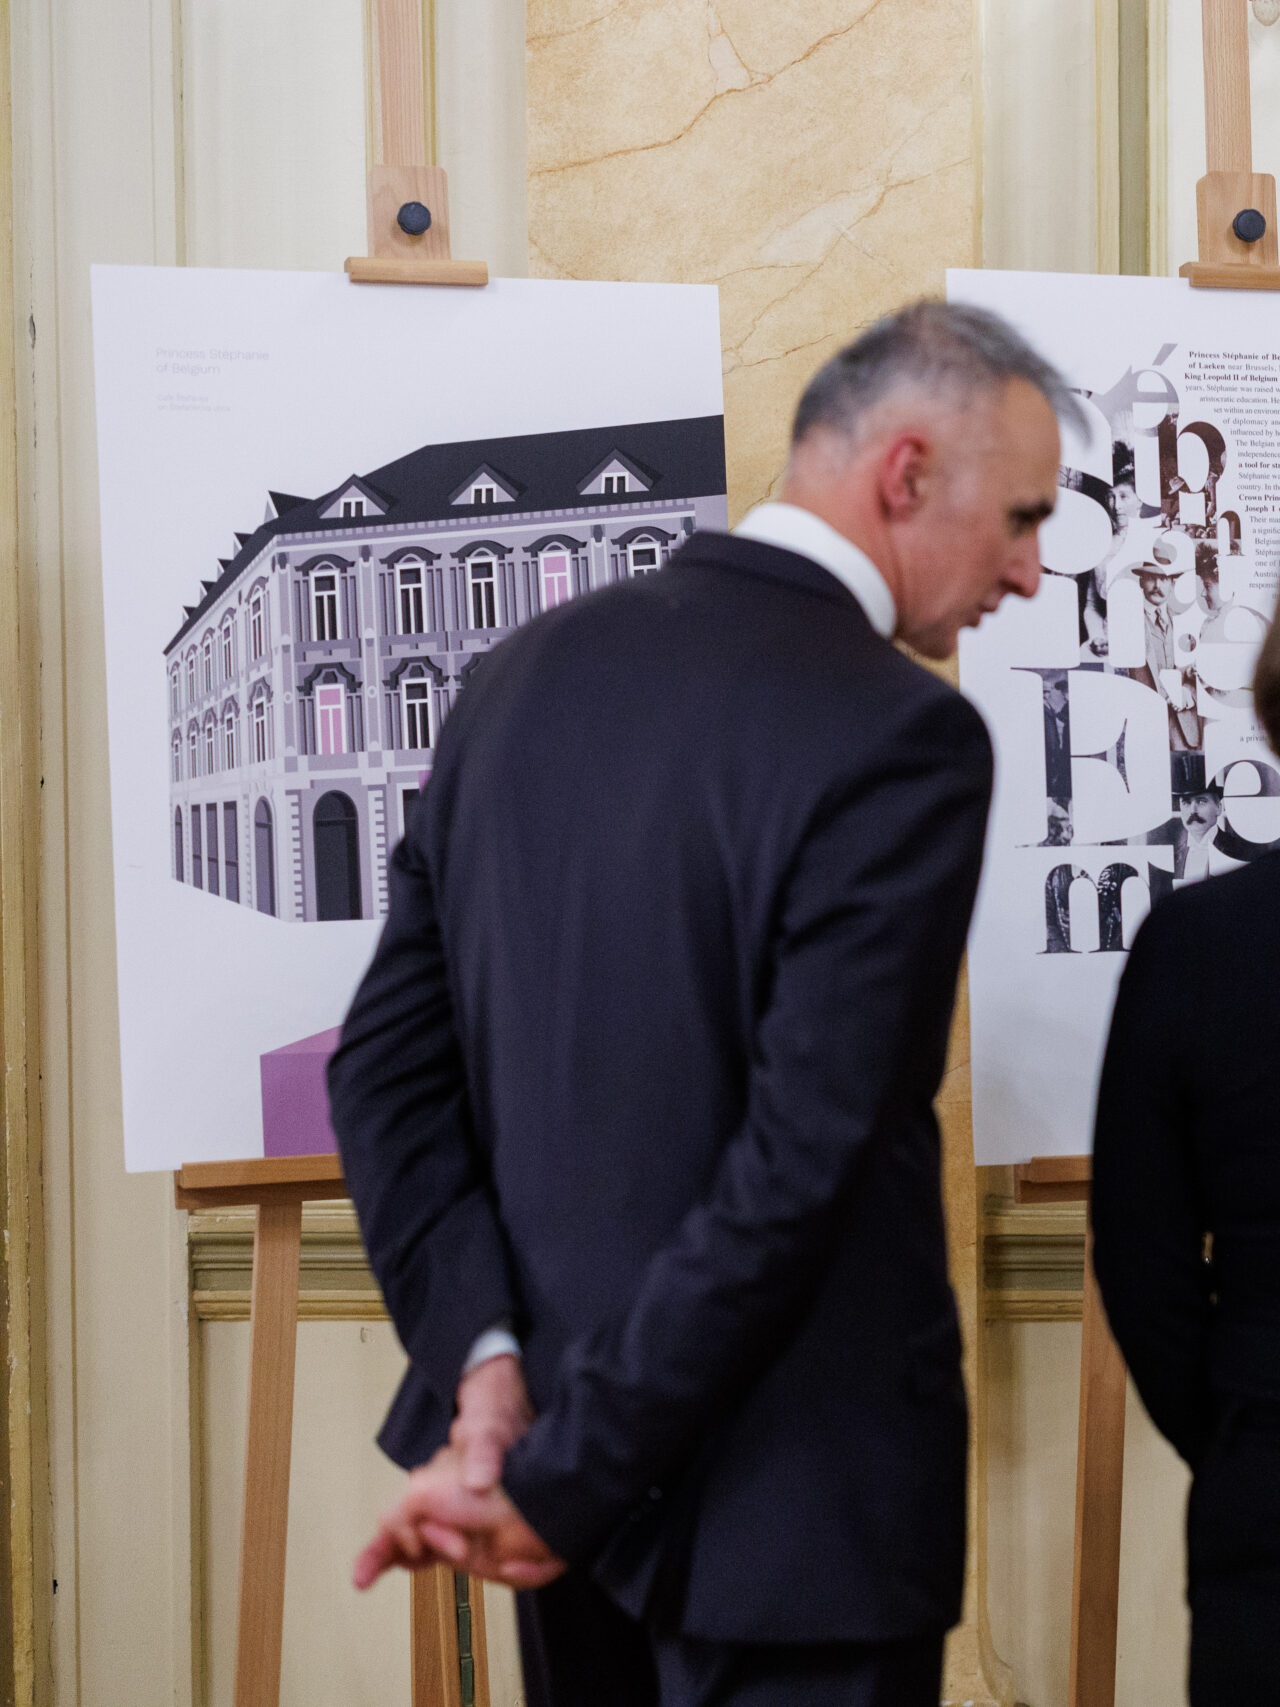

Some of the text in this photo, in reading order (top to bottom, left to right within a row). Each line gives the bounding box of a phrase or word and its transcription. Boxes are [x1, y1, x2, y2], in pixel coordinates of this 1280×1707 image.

[1188, 351, 1220, 359] Princess
[1222, 352, 1259, 360] Stéphanie
[1183, 372, 1201, 380] King
[1202, 373, 1231, 381] Leopold
[1232, 373, 1239, 381] II
[1249, 374, 1278, 382] Belgium
[1259, 461, 1270, 469] for
